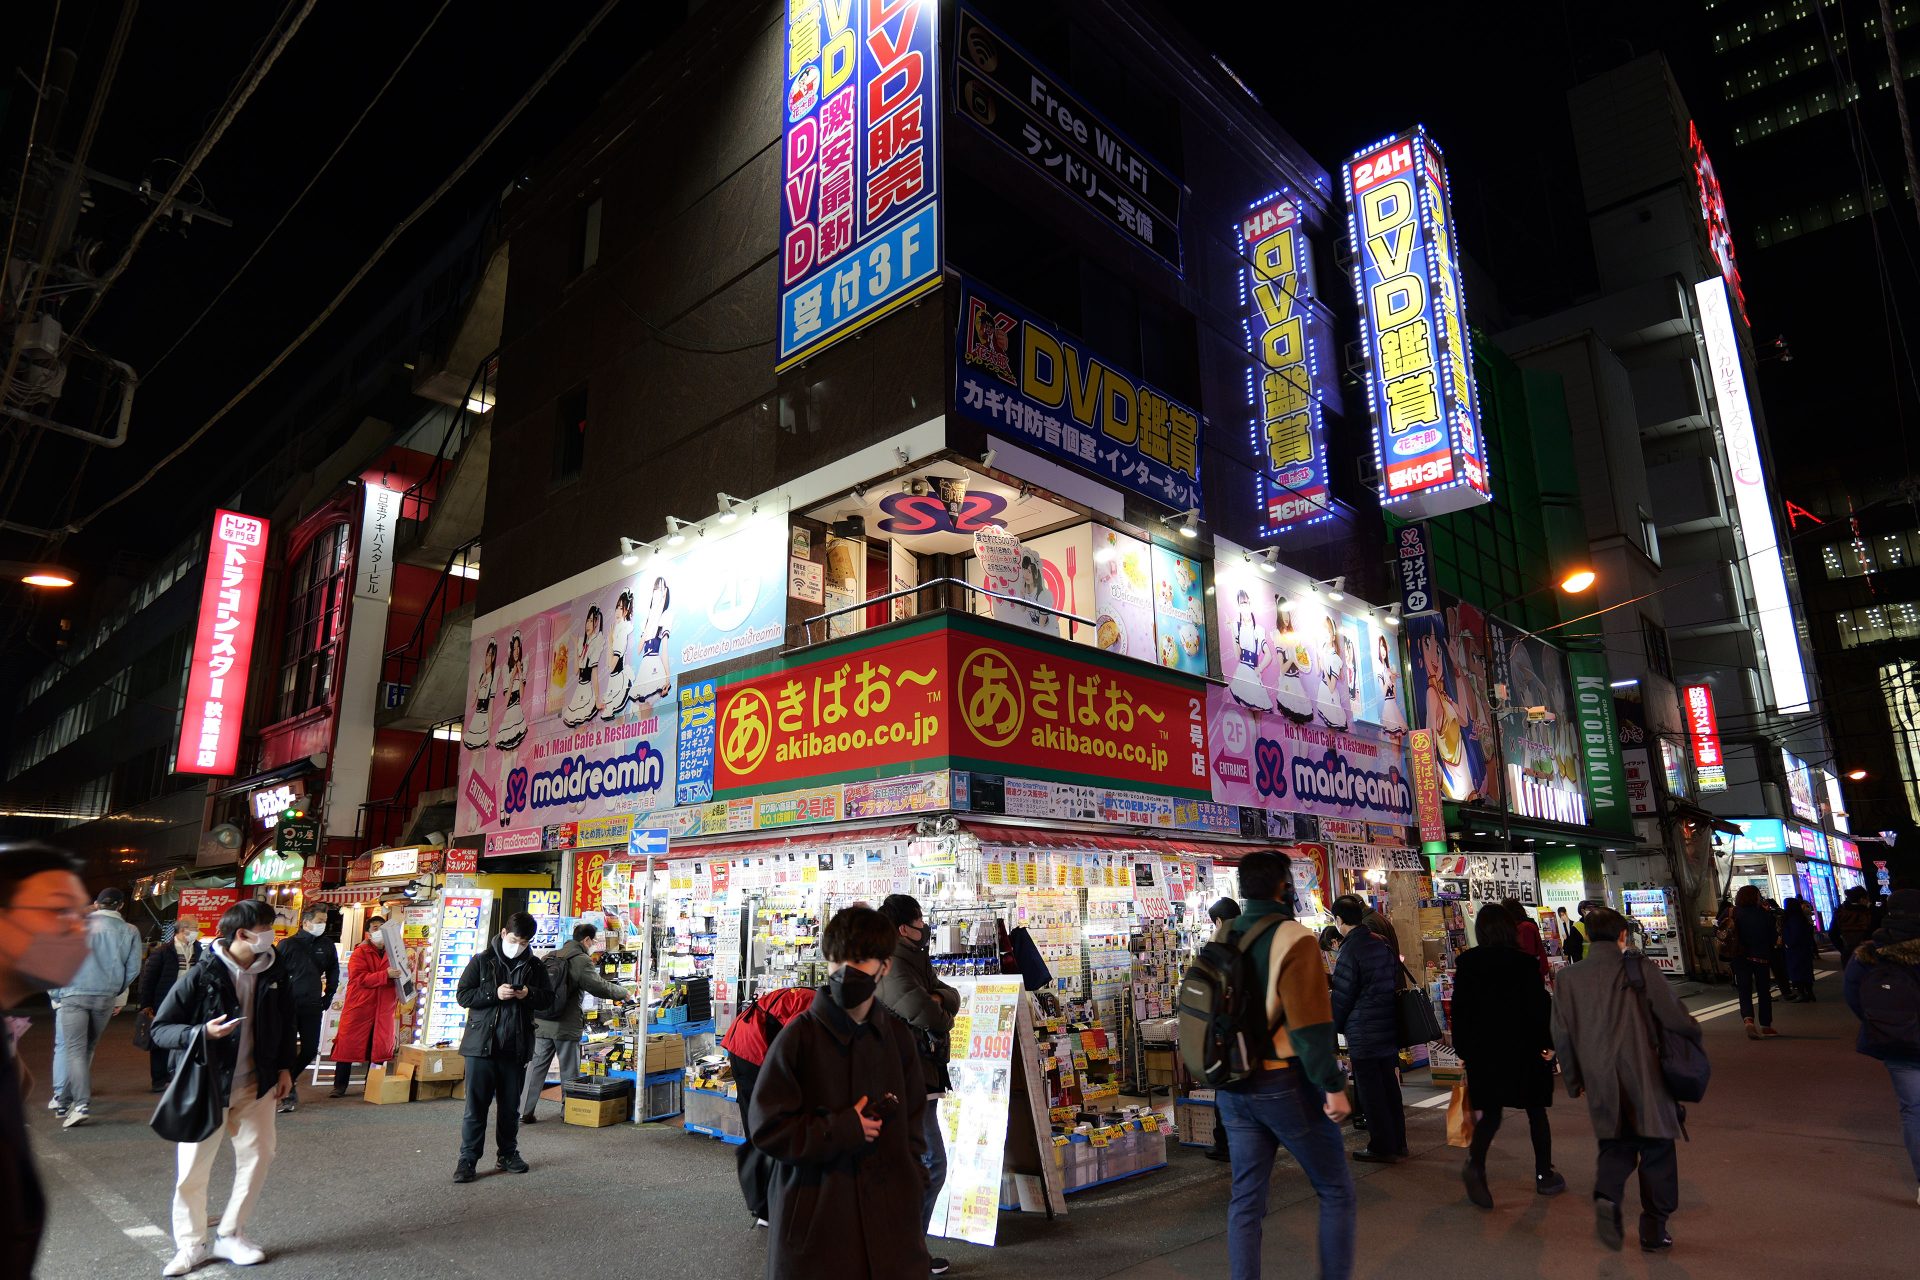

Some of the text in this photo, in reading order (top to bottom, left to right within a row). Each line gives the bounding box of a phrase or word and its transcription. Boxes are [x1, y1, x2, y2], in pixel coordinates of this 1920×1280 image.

[1030, 75, 1148, 194] Free Wi-Fi
[1355, 142, 1411, 189] 24H
[1023, 123, 1153, 244] ランドリー完備
[1361, 180, 1440, 436] DVD鑑賞
[1021, 320, 1199, 483] DVD鑑賞
[1389, 455, 1453, 492] 受付3F
[224, 528, 255, 543] 専門店
[225, 516, 257, 532] トレカ
[1401, 544, 1425, 557] No.1
[1401, 561, 1415, 591] カフェ
[1413, 555, 1427, 591] メイド
[1409, 594, 1426, 608] 2F
[927, 691, 941, 703] TM
[681, 703, 715, 730] アニメ
[1226, 716, 1243, 744] 2F
[534, 743, 551, 760] No.1
[552, 738, 574, 756] Maid
[574, 733, 595, 752] Cafe
[604, 716, 660, 744] Restaurant
[680, 736, 710, 750] フィギュア
[775, 712, 939, 763] akibaoo.co.jp
[1031, 724, 1169, 772] akibaoo.co.jp
[1158, 729, 1169, 740] TM
[1188, 698, 1206, 777] 2号店
[1284, 723, 1301, 740] No.1
[1301, 727, 1320, 744] Maid
[1320, 733, 1336, 750] Cafe
[1343, 736, 1378, 757] Restaurant
[1576, 675, 1615, 809] KOTOBUKIYA
[680, 747, 712, 761] ガチャガチャ
[680, 757, 709, 770] PCゲーム
[531, 749, 661, 807] maidreamin
[679, 768, 702, 781] おみやげ
[1219, 761, 1248, 778] ENTRANCE
[1294, 758, 1410, 808] maidreamin
[469, 776, 495, 815] ENTRANCE
[679, 784, 709, 801] 地下へ
[796, 795, 836, 820] 2号店
[446, 860, 476, 871] ドネルサンド
[182, 895, 236, 907] ドラゴンスター
[528, 890, 561, 903] DVD
[1472, 879, 1534, 902] 激安販売店
